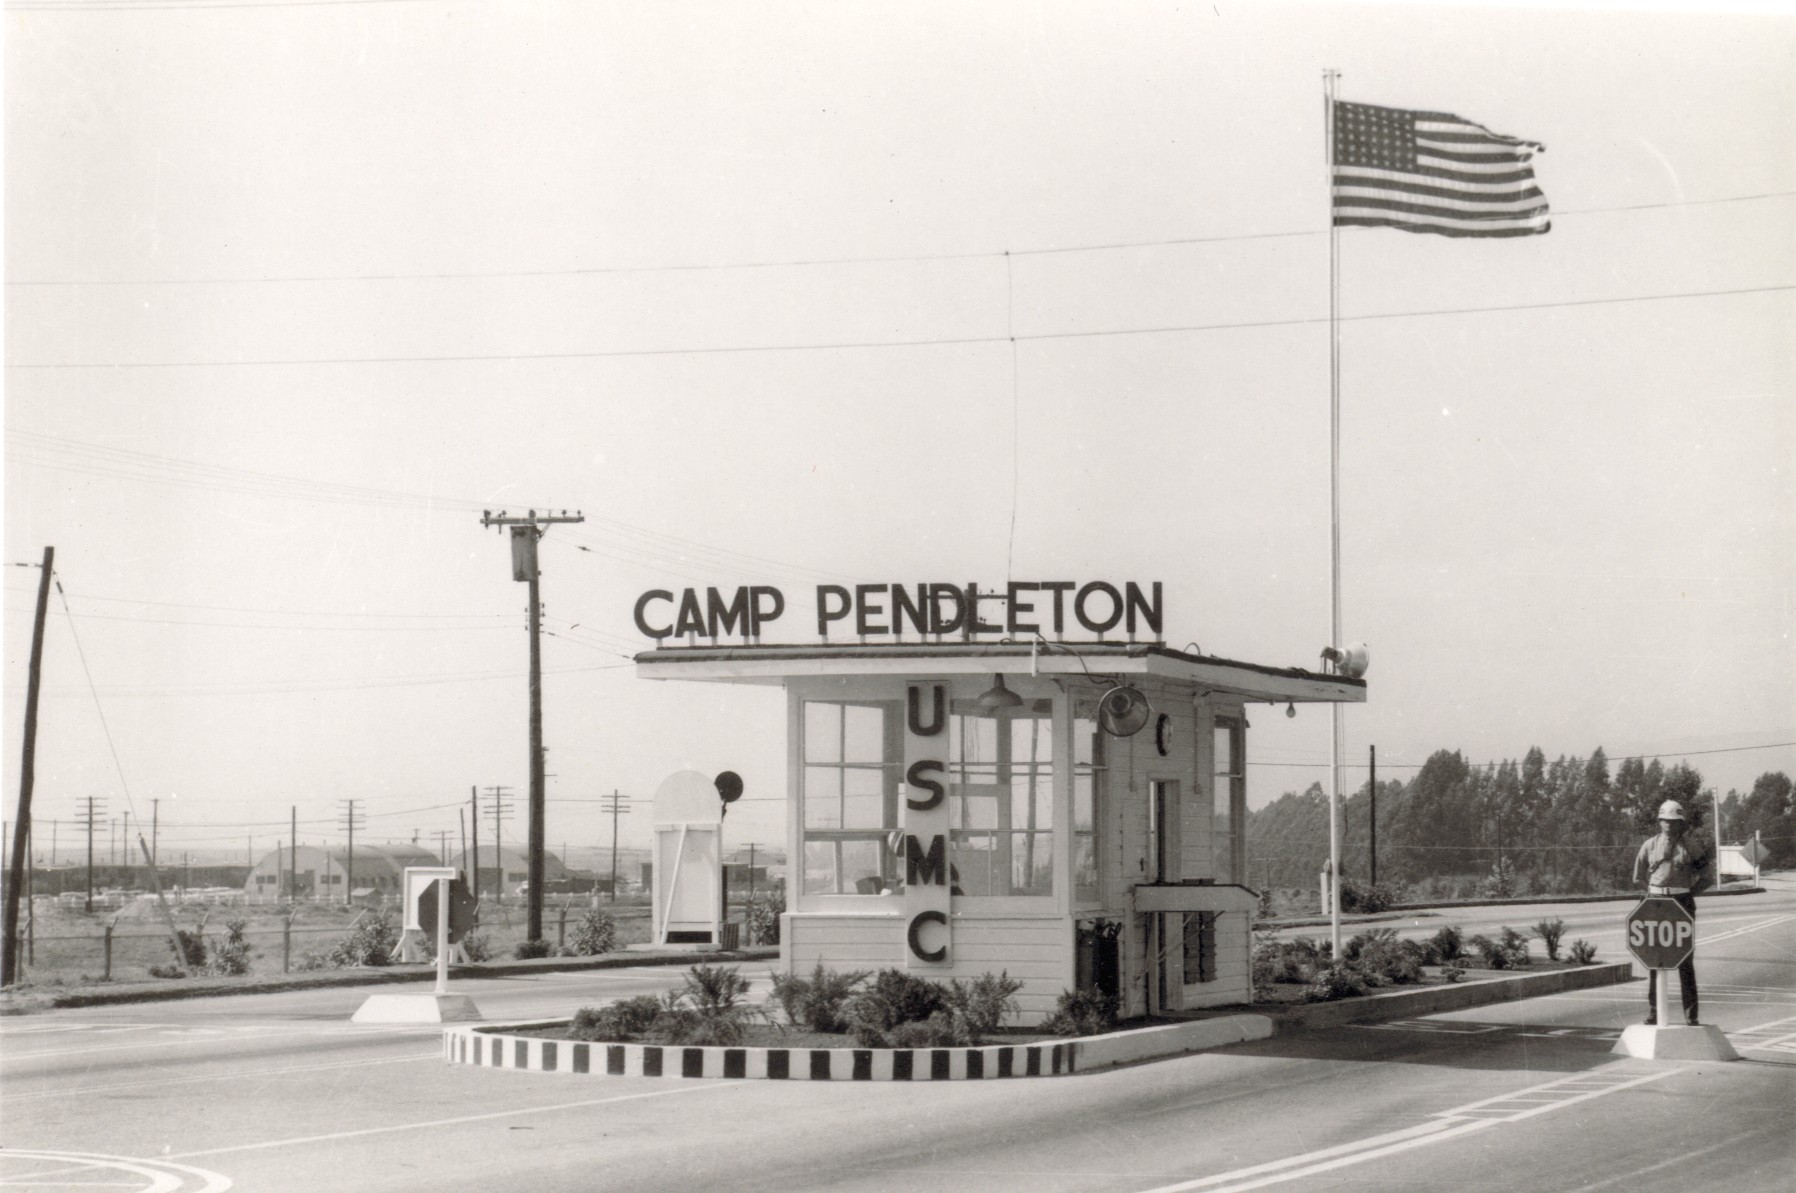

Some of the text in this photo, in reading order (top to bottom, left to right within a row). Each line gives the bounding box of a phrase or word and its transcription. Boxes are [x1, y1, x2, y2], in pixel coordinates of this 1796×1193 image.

[634, 581, 1163, 638] CAMP PENDLETON
[1629, 920, 1692, 948] STOP
